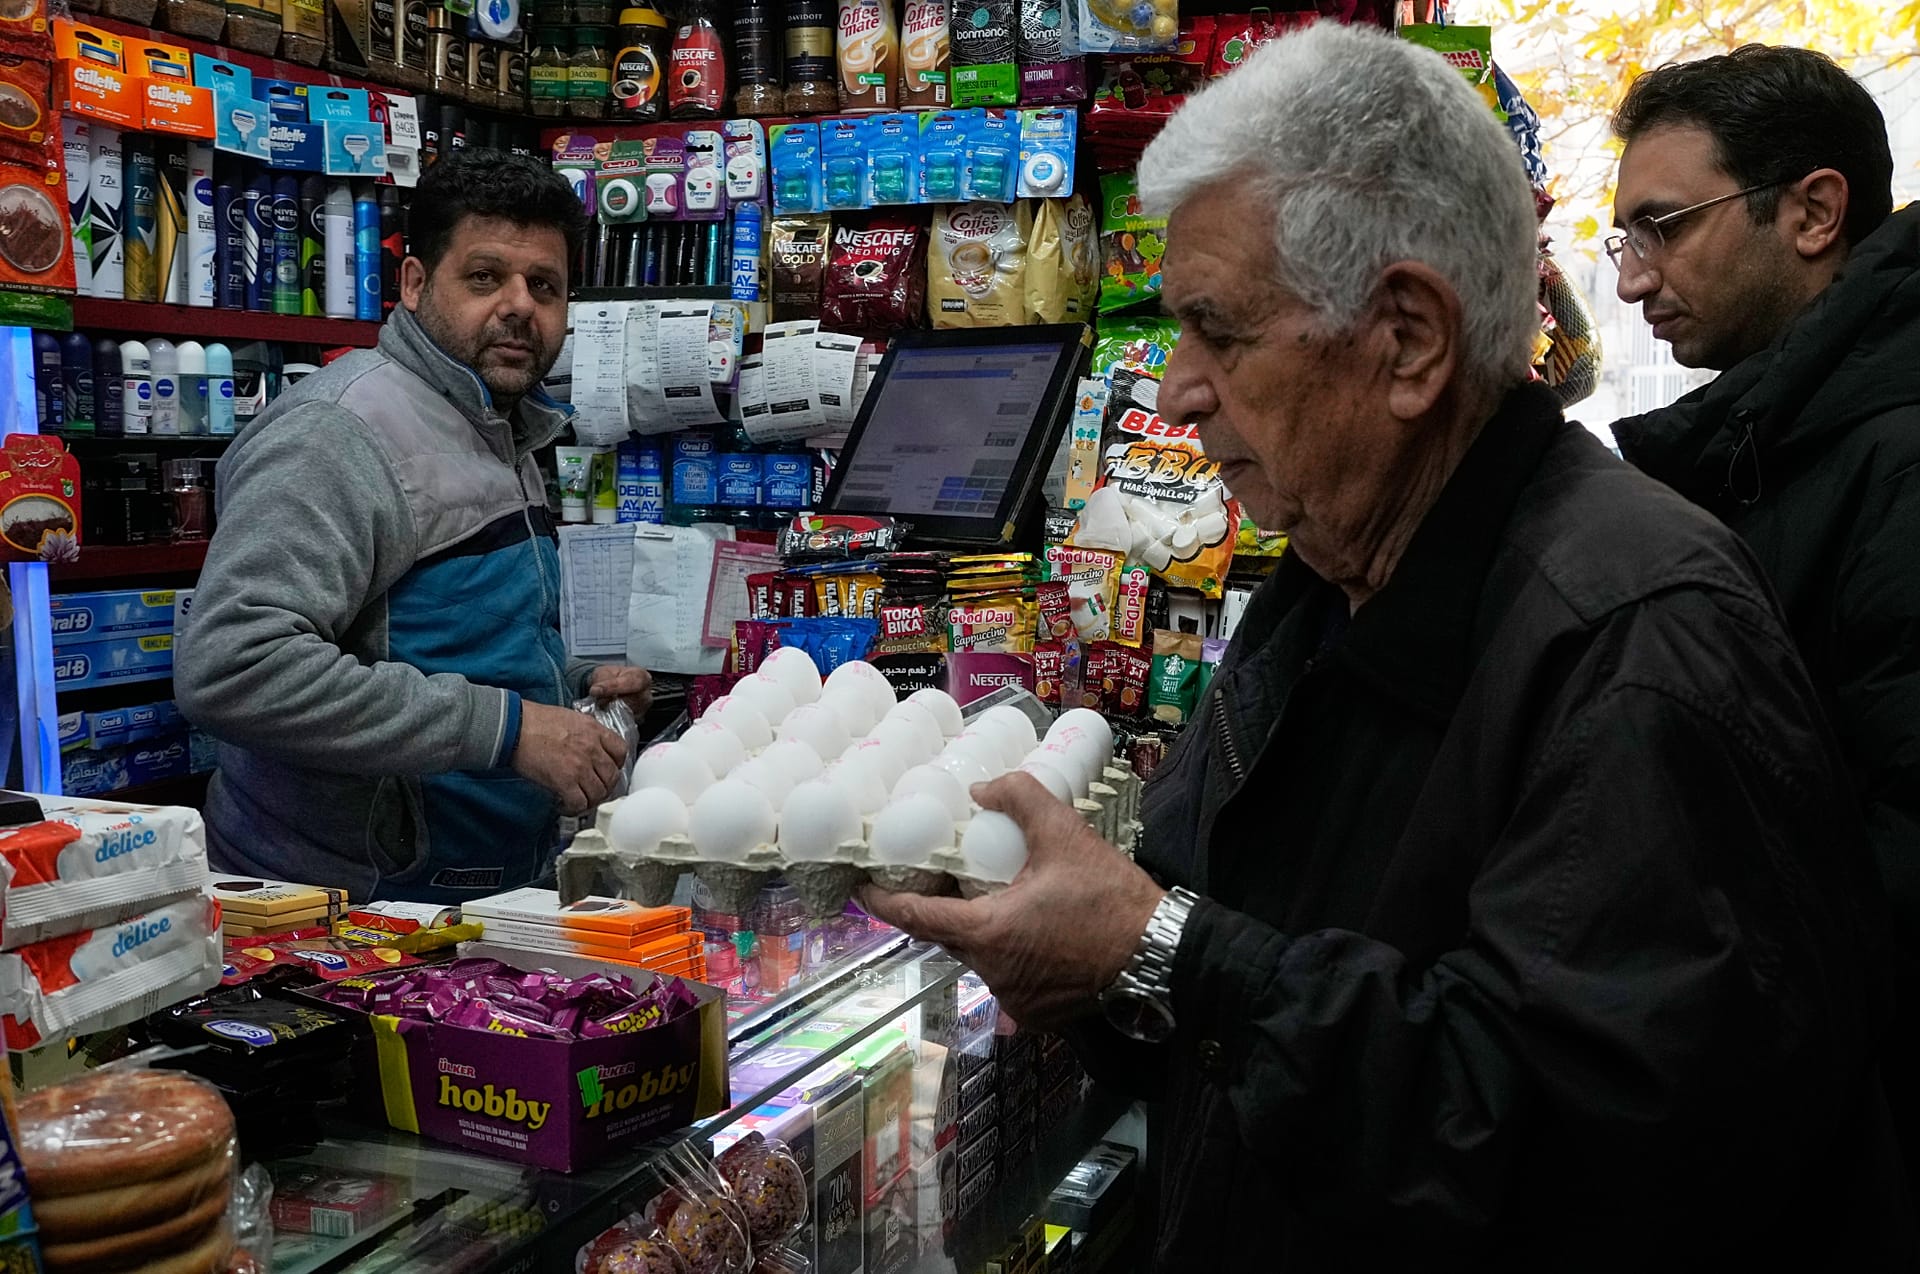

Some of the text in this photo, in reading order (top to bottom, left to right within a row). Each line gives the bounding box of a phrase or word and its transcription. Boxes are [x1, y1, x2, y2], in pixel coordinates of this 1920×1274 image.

[839, 4, 880, 29] Coffee
[903, 3, 945, 27] Coffee
[909, 16, 945, 34] mate
[844, 18, 880, 38] mate
[956, 27, 1004, 40] bonmano
[1024, 28, 1062, 40] bonma
[74, 66, 121, 92] Gillette
[147, 84, 193, 105] Gillette
[269, 125, 307, 144] Gillette
[950, 211, 1000, 232] Coffee
[963, 223, 1000, 238] mate
[782, 253, 816, 264] GOLD
[848, 246, 901, 257] RED MUG
[812, 466, 825, 504] Signal
[1122, 480, 1198, 503] MARSHMALLOW
[1046, 547, 1114, 569] Good Day
[1127, 568, 1146, 610] Good
[757, 586, 767, 620] KLAS
[794, 589, 805, 619] KLAS
[826, 582, 839, 618] KLAS
[864, 589, 875, 619] KLAS
[883, 606, 922, 619] TORA
[949, 608, 1014, 626] Good Day
[887, 620, 922, 635] BIKA
[1121, 609, 1141, 640] Day
[880, 639, 931, 653] Cappuccino
[953, 626, 1006, 647] Cappuccino
[908, 665, 927, 676] طعم
[439, 1057, 477, 1079] ÜLKER
[585, 1061, 697, 1119] hobby
[439, 1075, 551, 1130] hobby
